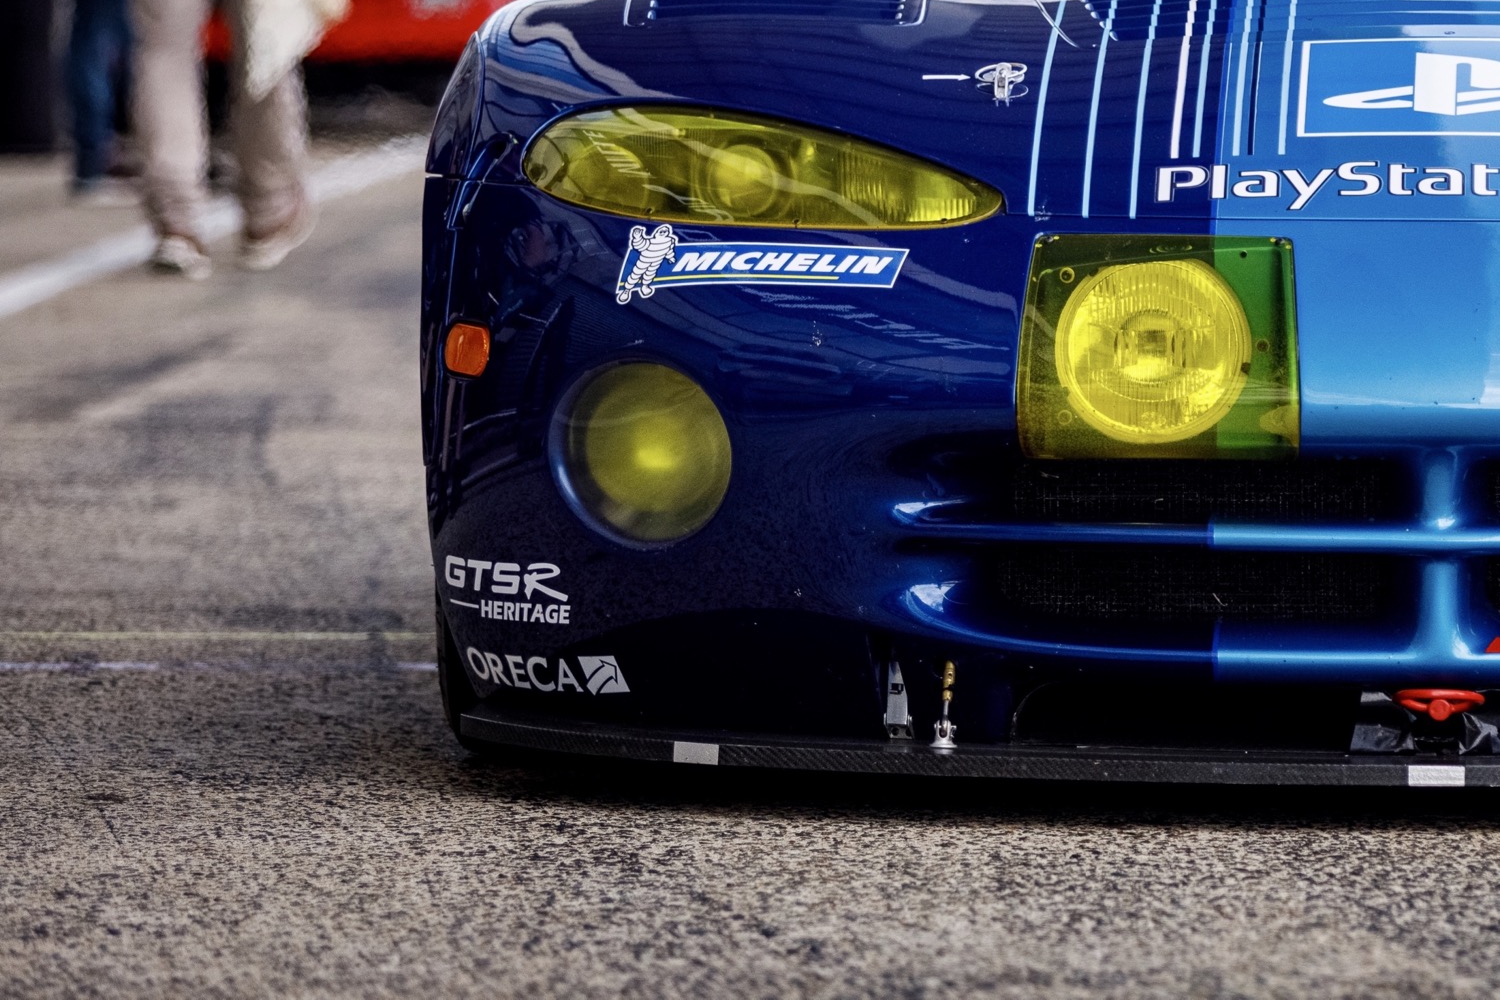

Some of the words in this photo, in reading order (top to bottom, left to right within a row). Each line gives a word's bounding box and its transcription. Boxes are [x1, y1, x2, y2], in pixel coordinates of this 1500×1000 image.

[671, 250, 893, 276] MICHELIN
[445, 554, 569, 602] GTSR
[480, 599, 571, 624] HERITAGE
[466, 646, 585, 692] ORECA
